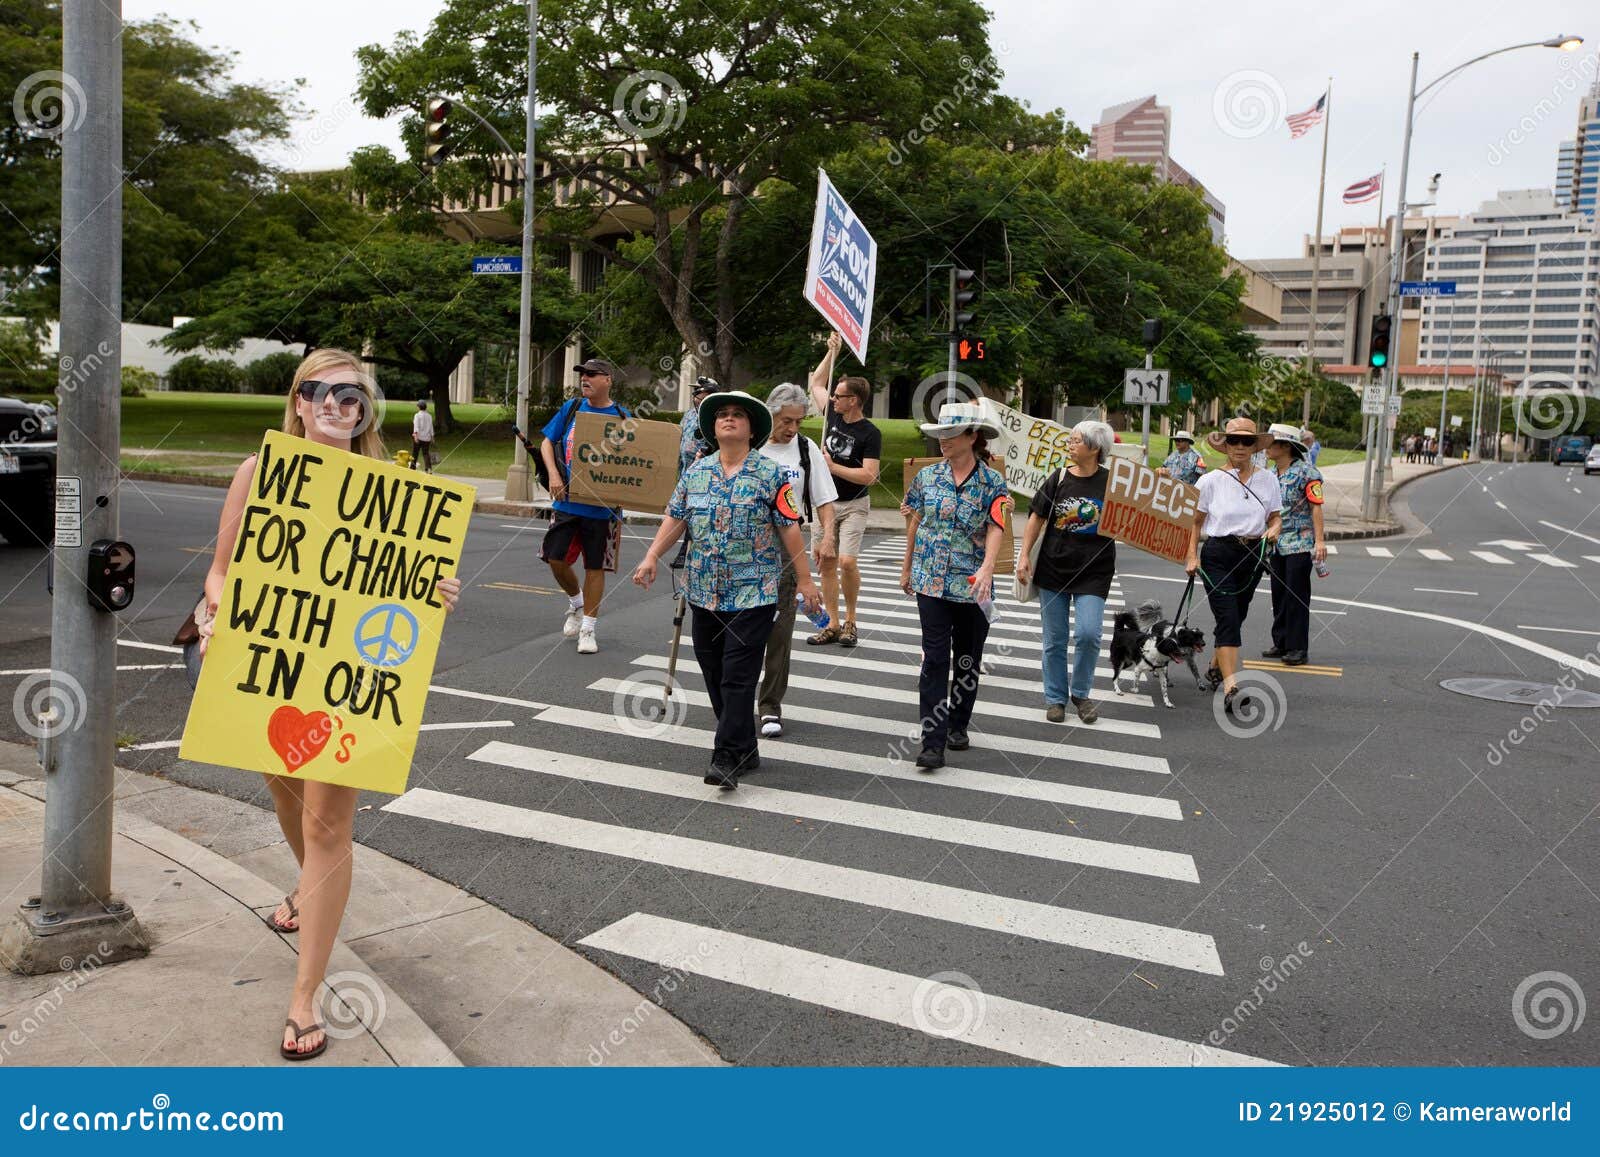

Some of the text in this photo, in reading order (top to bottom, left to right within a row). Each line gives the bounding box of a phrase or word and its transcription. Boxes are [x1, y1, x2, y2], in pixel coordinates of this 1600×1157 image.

[476, 263, 512, 272] PUNCHBOWL
[831, 261, 866, 314] SHOW
[840, 227, 869, 290] FOX
[1402, 286, 1440, 295] PUNCHBOWL
[977, 342, 984, 359] 5
[1000, 409, 1070, 452] the BEG
[258, 443, 463, 543] WE UNITE
[234, 505, 455, 609] FOR CHANGE
[229, 578, 336, 649] WITH
[237, 643, 402, 726] IN OUR
